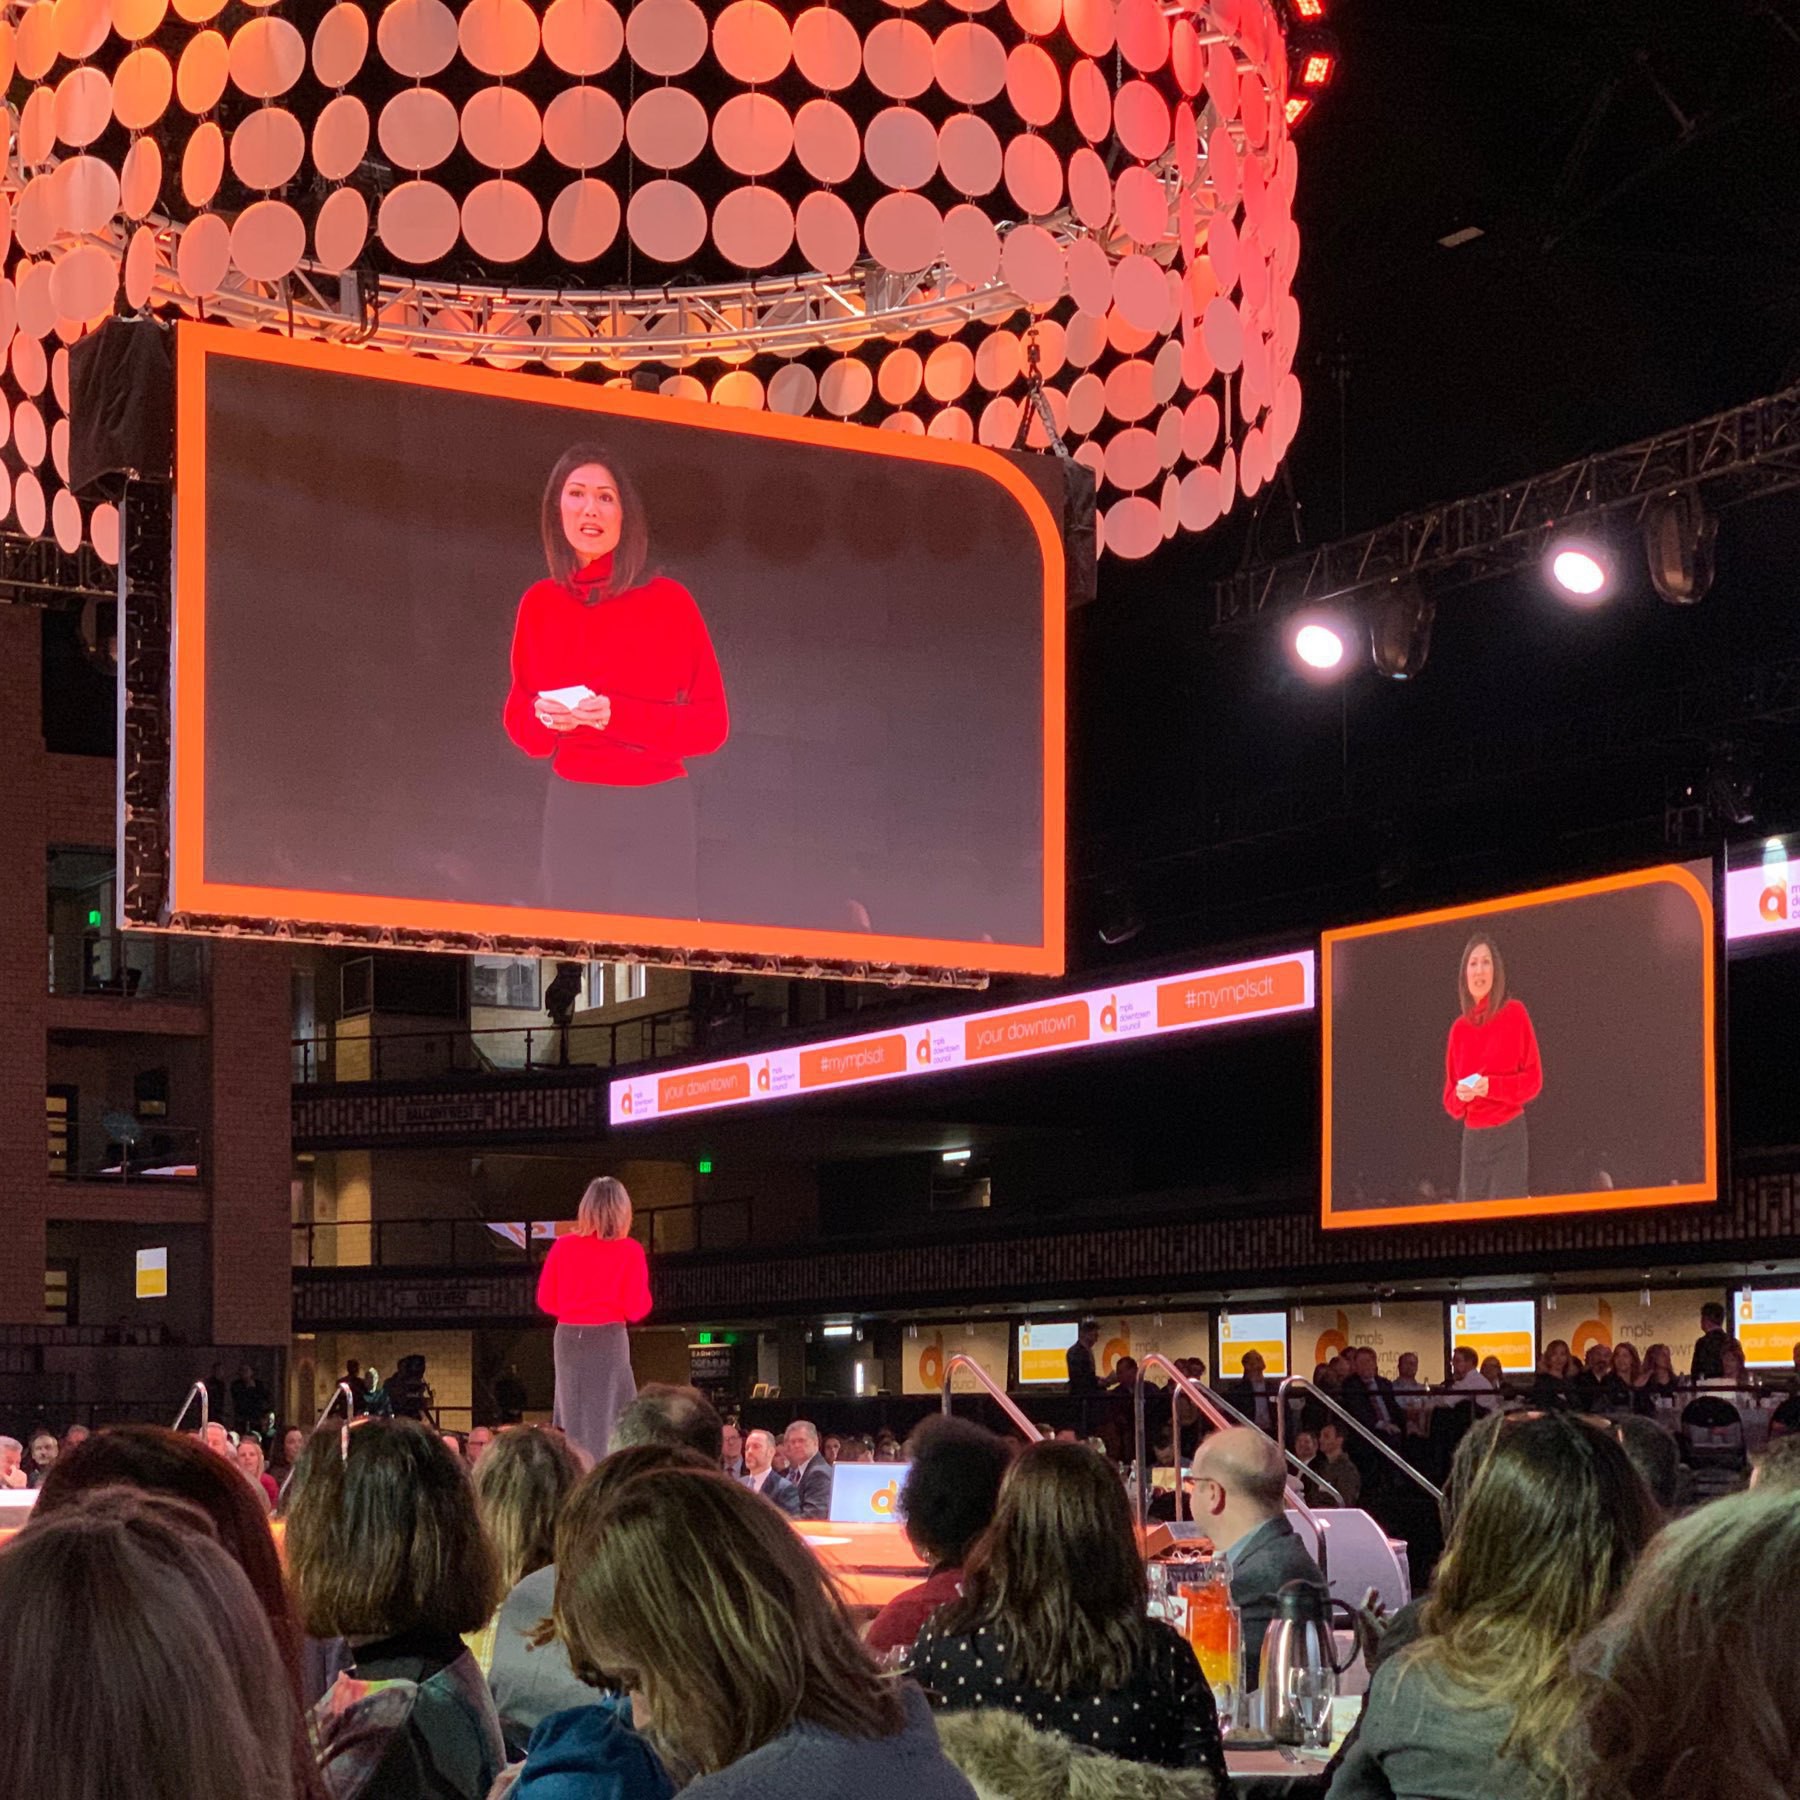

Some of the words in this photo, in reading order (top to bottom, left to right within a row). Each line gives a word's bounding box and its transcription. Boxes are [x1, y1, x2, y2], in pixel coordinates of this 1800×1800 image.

[1185, 975, 1274, 1008] #mymplsdt
[976, 1027, 1004, 1050] your
[1008, 1014, 1076, 1041] downtown
[820, 1045, 885, 1073] #mymplsdt
[664, 1083, 685, 1104] your
[686, 1075, 738, 1097] downtown
[1620, 1322, 1654, 1339] mpls
